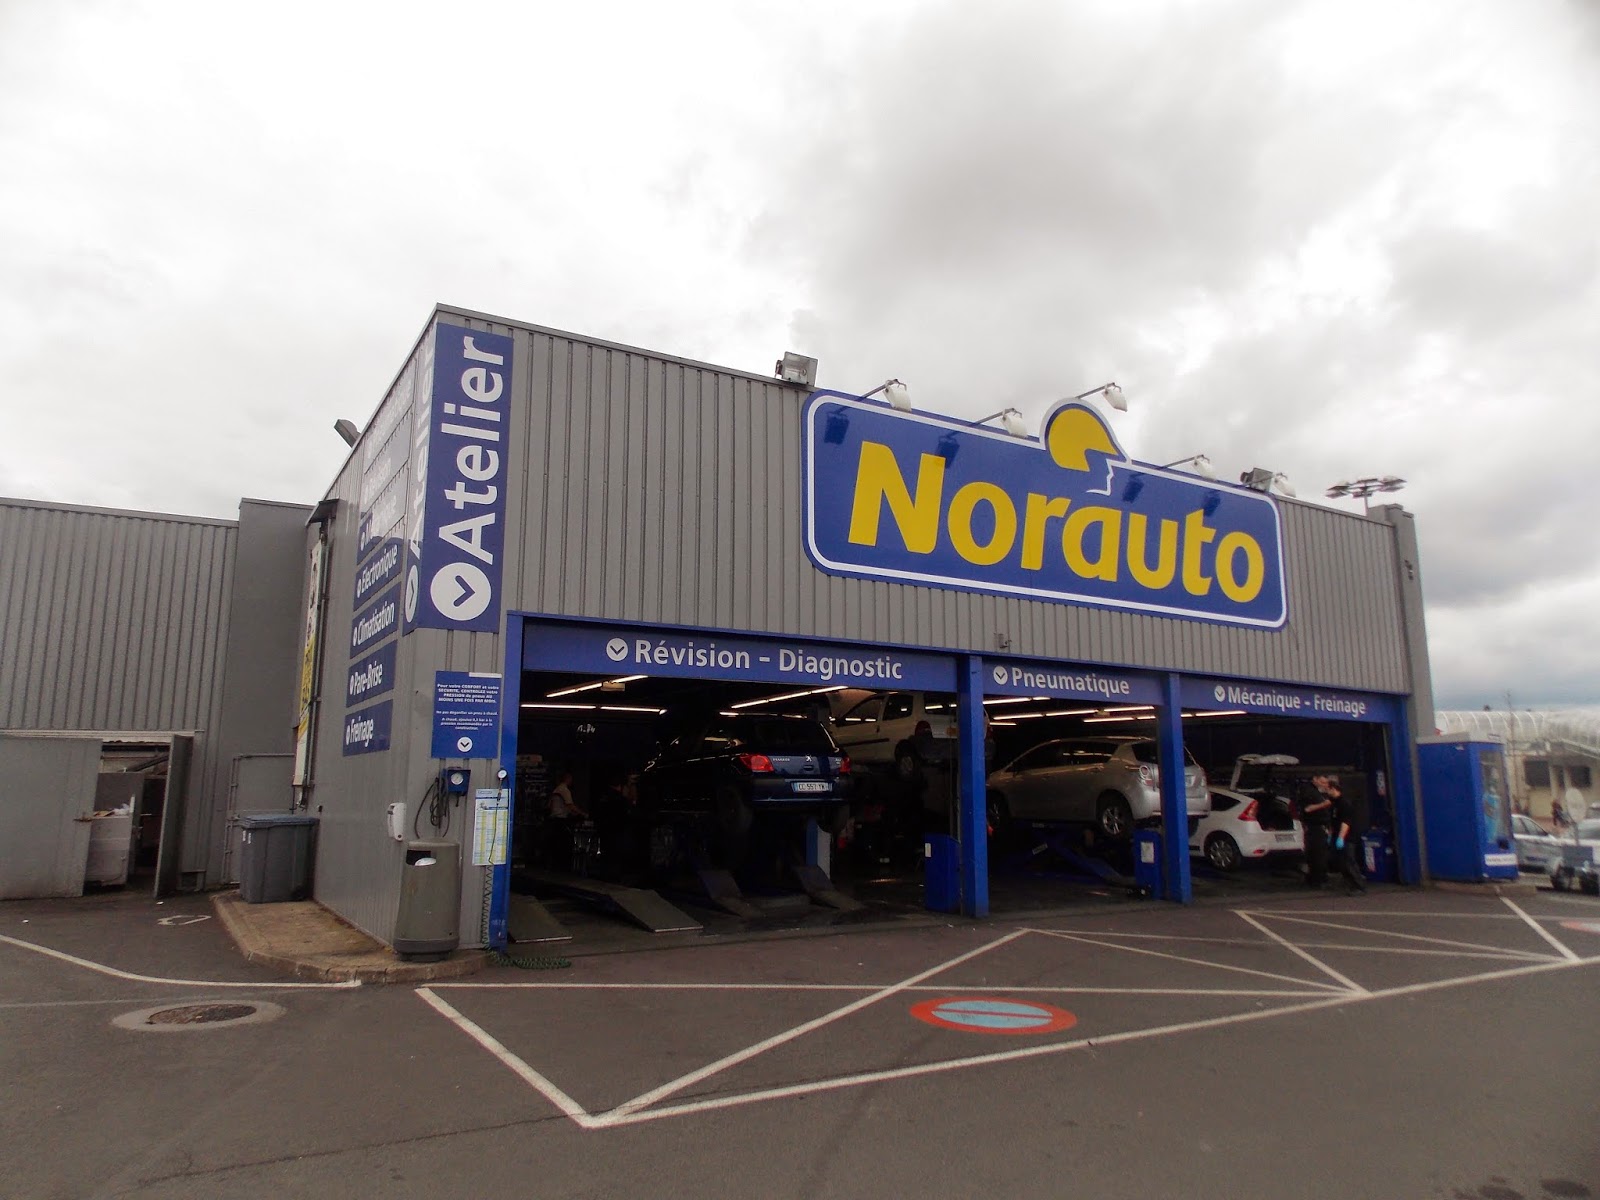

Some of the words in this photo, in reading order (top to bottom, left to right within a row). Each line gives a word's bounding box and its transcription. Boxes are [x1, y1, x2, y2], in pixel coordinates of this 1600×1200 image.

[439, 336, 504, 565] Atelier
[848, 440, 1265, 603] Norauto
[357, 601, 395, 645] Climatisation
[354, 660, 383, 695] Pare-Brise
[635, 639, 750, 669] Révision
[779, 648, 902, 681] Diagnostic
[1012, 667, 1130, 698] Pneumatique
[1228, 686, 1301, 711] Mécanique
[1313, 696, 1367, 719] Freinage
[350, 716, 374, 747] Freinage
